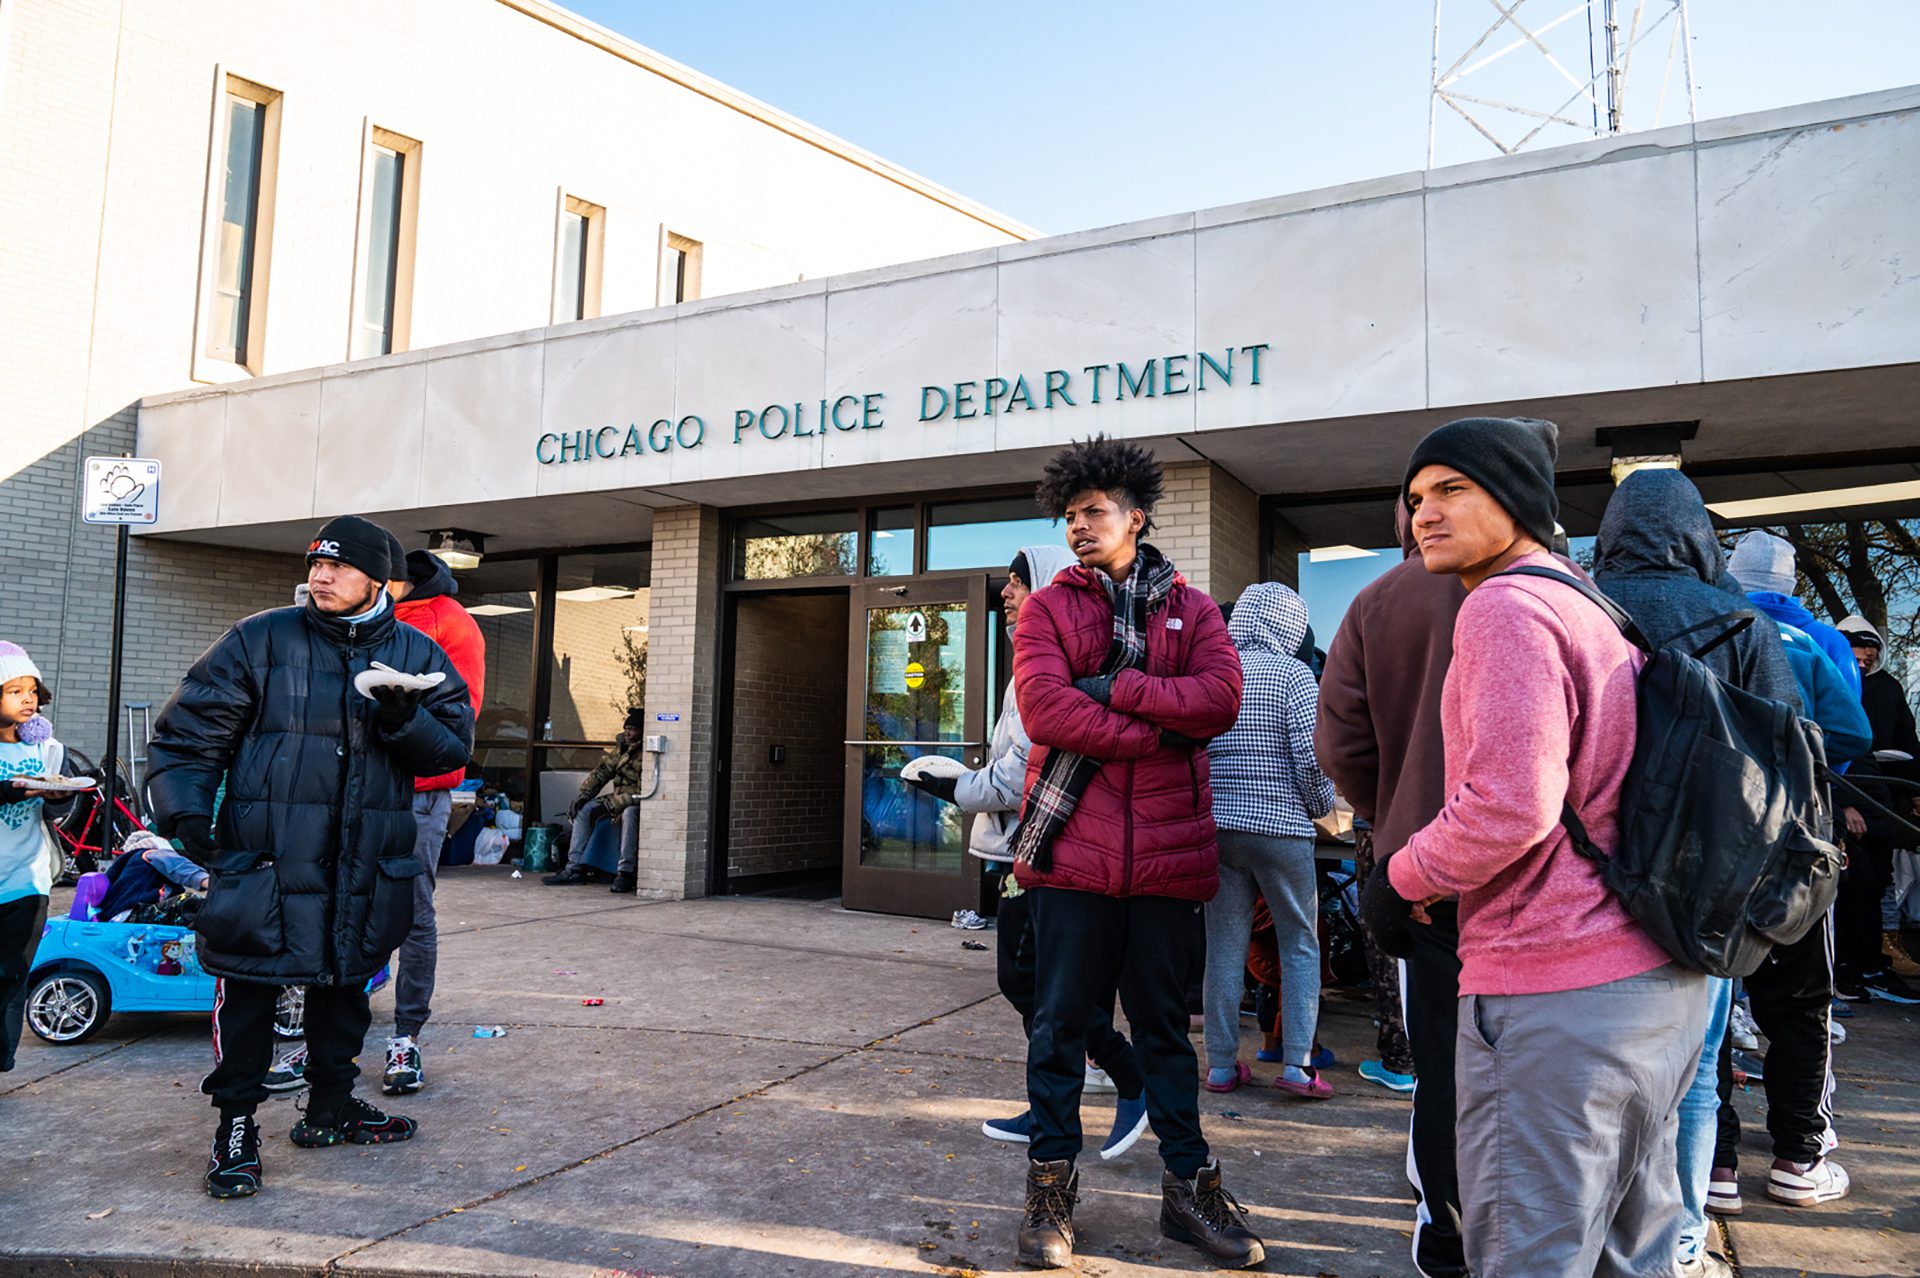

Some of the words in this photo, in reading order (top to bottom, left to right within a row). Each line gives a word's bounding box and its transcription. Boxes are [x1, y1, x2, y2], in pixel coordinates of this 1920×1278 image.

[536, 415, 705, 465] CHICAGO
[733, 393, 885, 444] POLICE
[918, 343, 1270, 422] DEPARTMENT
